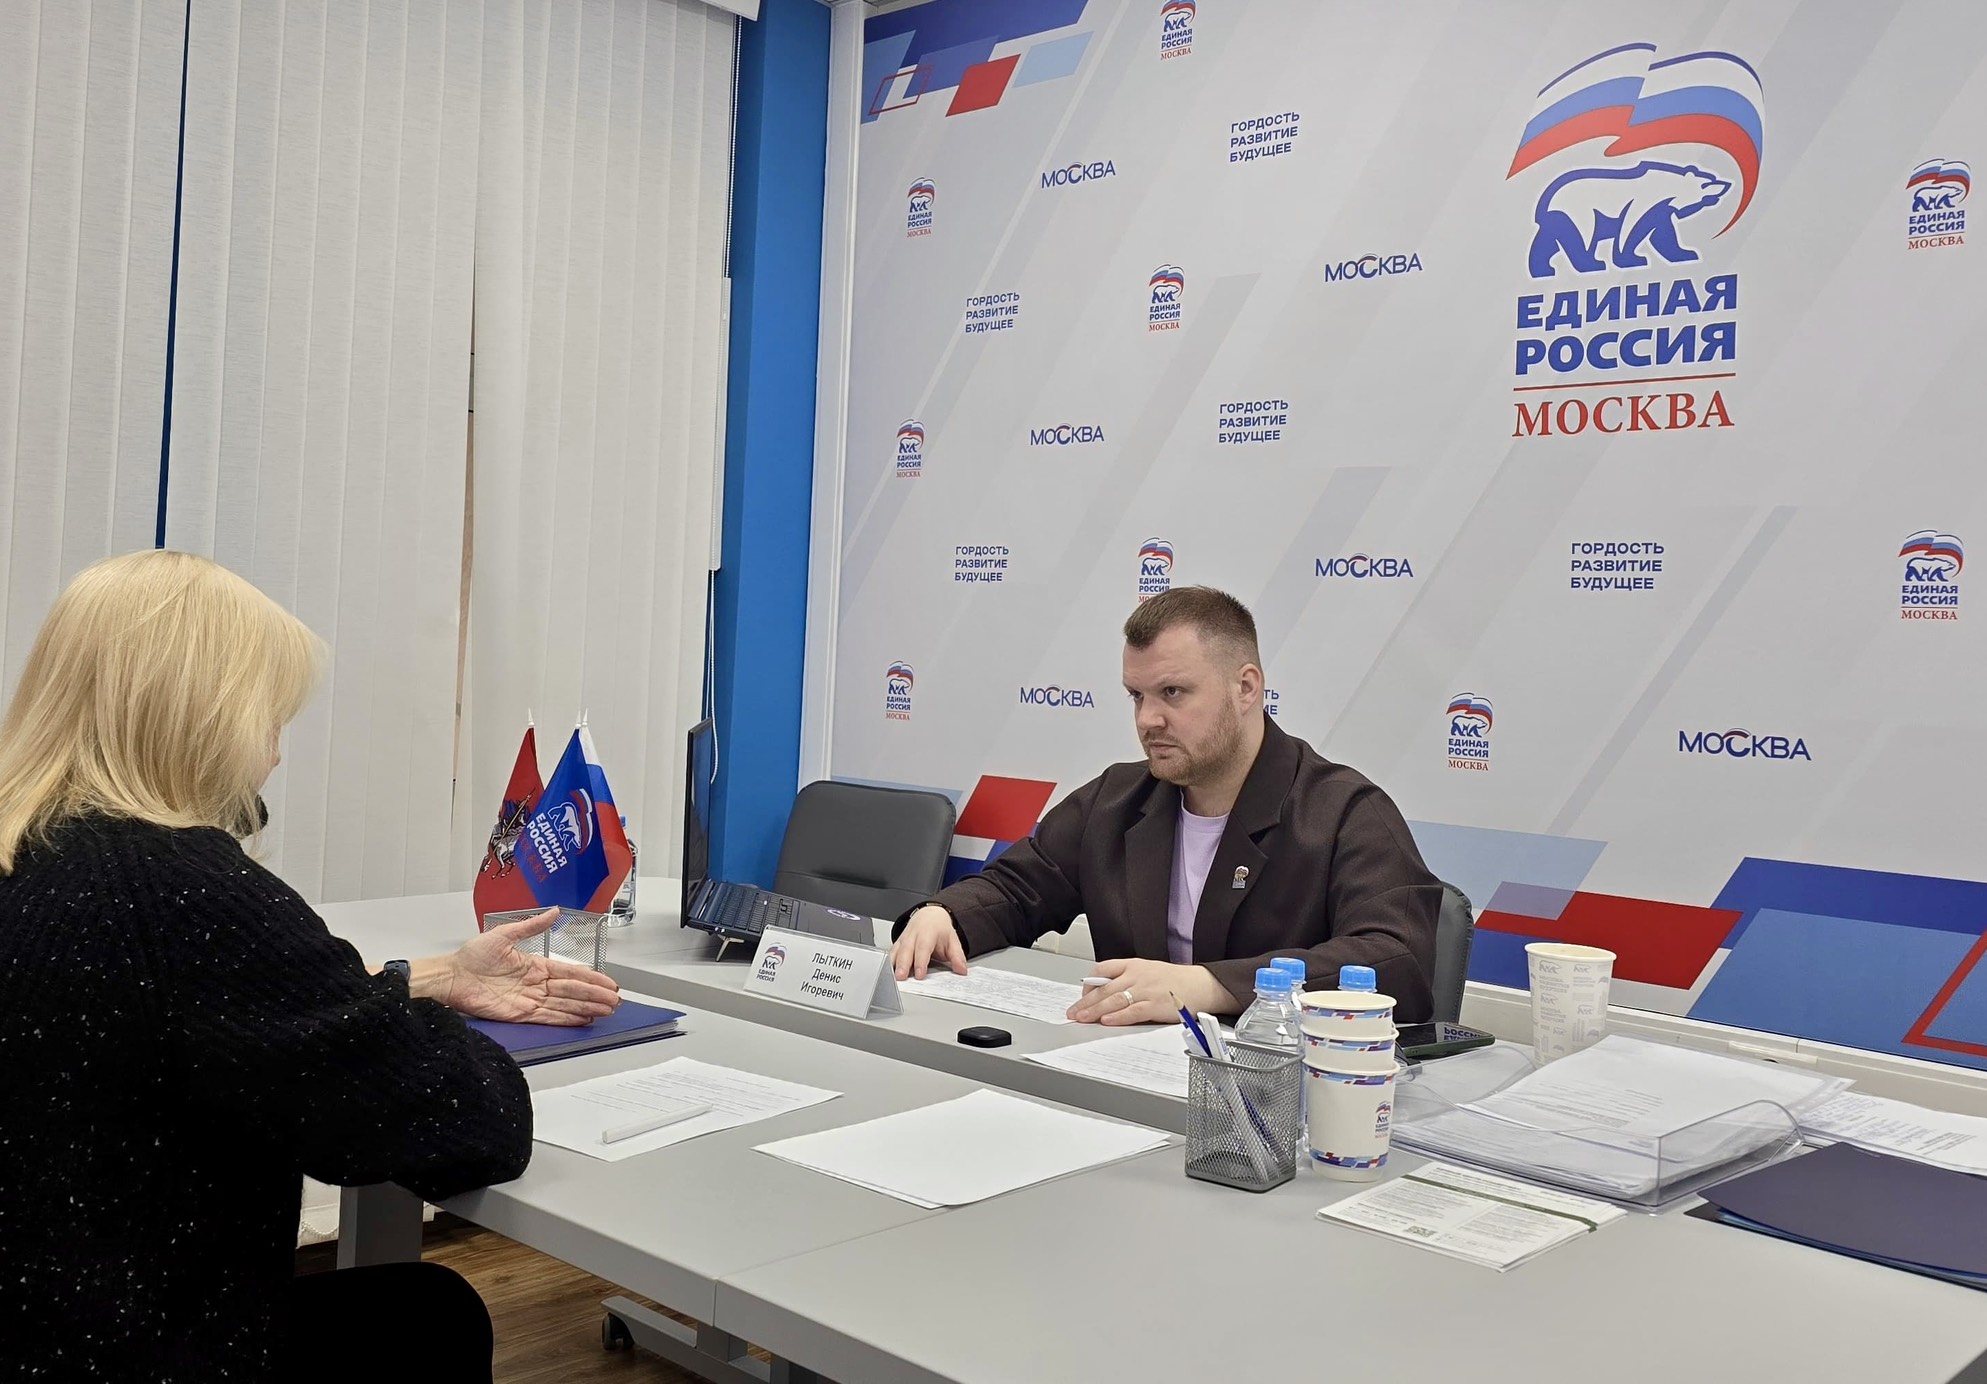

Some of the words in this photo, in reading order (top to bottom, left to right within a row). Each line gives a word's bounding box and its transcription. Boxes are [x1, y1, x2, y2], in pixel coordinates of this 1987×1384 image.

[1161, 29, 1193, 41] ЕДИНАЯ
[1161, 36, 1192, 49] РОССИЯ
[1160, 48, 1192, 60] МОСКВА
[1231, 112, 1300, 133] ГОРДОСТЬ
[1230, 126, 1298, 148] РАЗВИТИЕ
[1230, 142, 1292, 162] БУДУЩЕЕ
[1041, 160, 1116, 189] МОСКВА
[907, 218, 932, 228] РОССИЯ
[908, 211, 932, 221] ЕДИНАЯ
[1909, 210, 1965, 225] ЕДИНАЯ
[906, 229, 931, 238] МОСКВА
[1908, 220, 1965, 236] РОССИЯ
[1908, 235, 1964, 250] МОСКВА
[1324, 253, 1423, 282] МОСКВА
[966, 292, 1020, 307] ГОРДОСТЬ
[1517, 273, 1738, 331] ЕДИНАЯ
[966, 305, 1018, 320] РАЗВИТИЕ
[1150, 303, 1181, 313] ЕДИНАЯ
[1149, 311, 1180, 321] РОССИЯ
[965, 319, 1013, 333] БУДУЩЕЕ
[1149, 322, 1180, 332] МОСКВА
[1515, 321, 1737, 375] РОССИЯ
[1219, 400, 1288, 414] ГОРДОСТЬ
[1512, 390, 1735, 437] МОСКВА
[1219, 414, 1287, 429] РАЗВИТИЕ
[1030, 424, 1104, 446] МОСКВА
[1218, 429, 1281, 444] БУДУЩЕЕ
[896, 461, 921, 469] РОССИЯ
[955, 546, 1009, 557] ГОРДОСТЬ
[1571, 542, 1665, 556] ГОРДОСТЬ
[955, 559, 1008, 569] РАЗВИТИЕ
[1315, 554, 1413, 578] МОСКВА
[1571, 560, 1662, 572] РАЗВИТИЕ
[954, 572, 1003, 583] БУДУЩЕЕ
[1138, 577, 1170, 585] ЕДИНАЯ
[1571, 577, 1654, 591] БУДУЩЕЕ
[1138, 585, 1170, 593] РОССИЯ
[1901, 585, 1958, 595] ЕДИНАЯ
[1901, 595, 1958, 605] РОССИЯ
[1901, 610, 1958, 620] МОСКВА
[1019, 685, 1094, 709] МОСКВА
[885, 712, 910, 720] МОСКВА
[1448, 738, 1489, 749] ЕДИНАЯ
[1679, 728, 1812, 762] МОСКВА
[1448, 747, 1489, 758] РОССИЯ
[1448, 760, 1489, 771] МОСКВА
[535, 812, 567, 867] ЕДИНАЯ
[526, 820, 559, 874] РОССИЯ
[811, 952, 854, 971] ЛЫТКИН
[811, 968, 842, 984] Денис
[800, 981, 845, 1001] Игоревич
